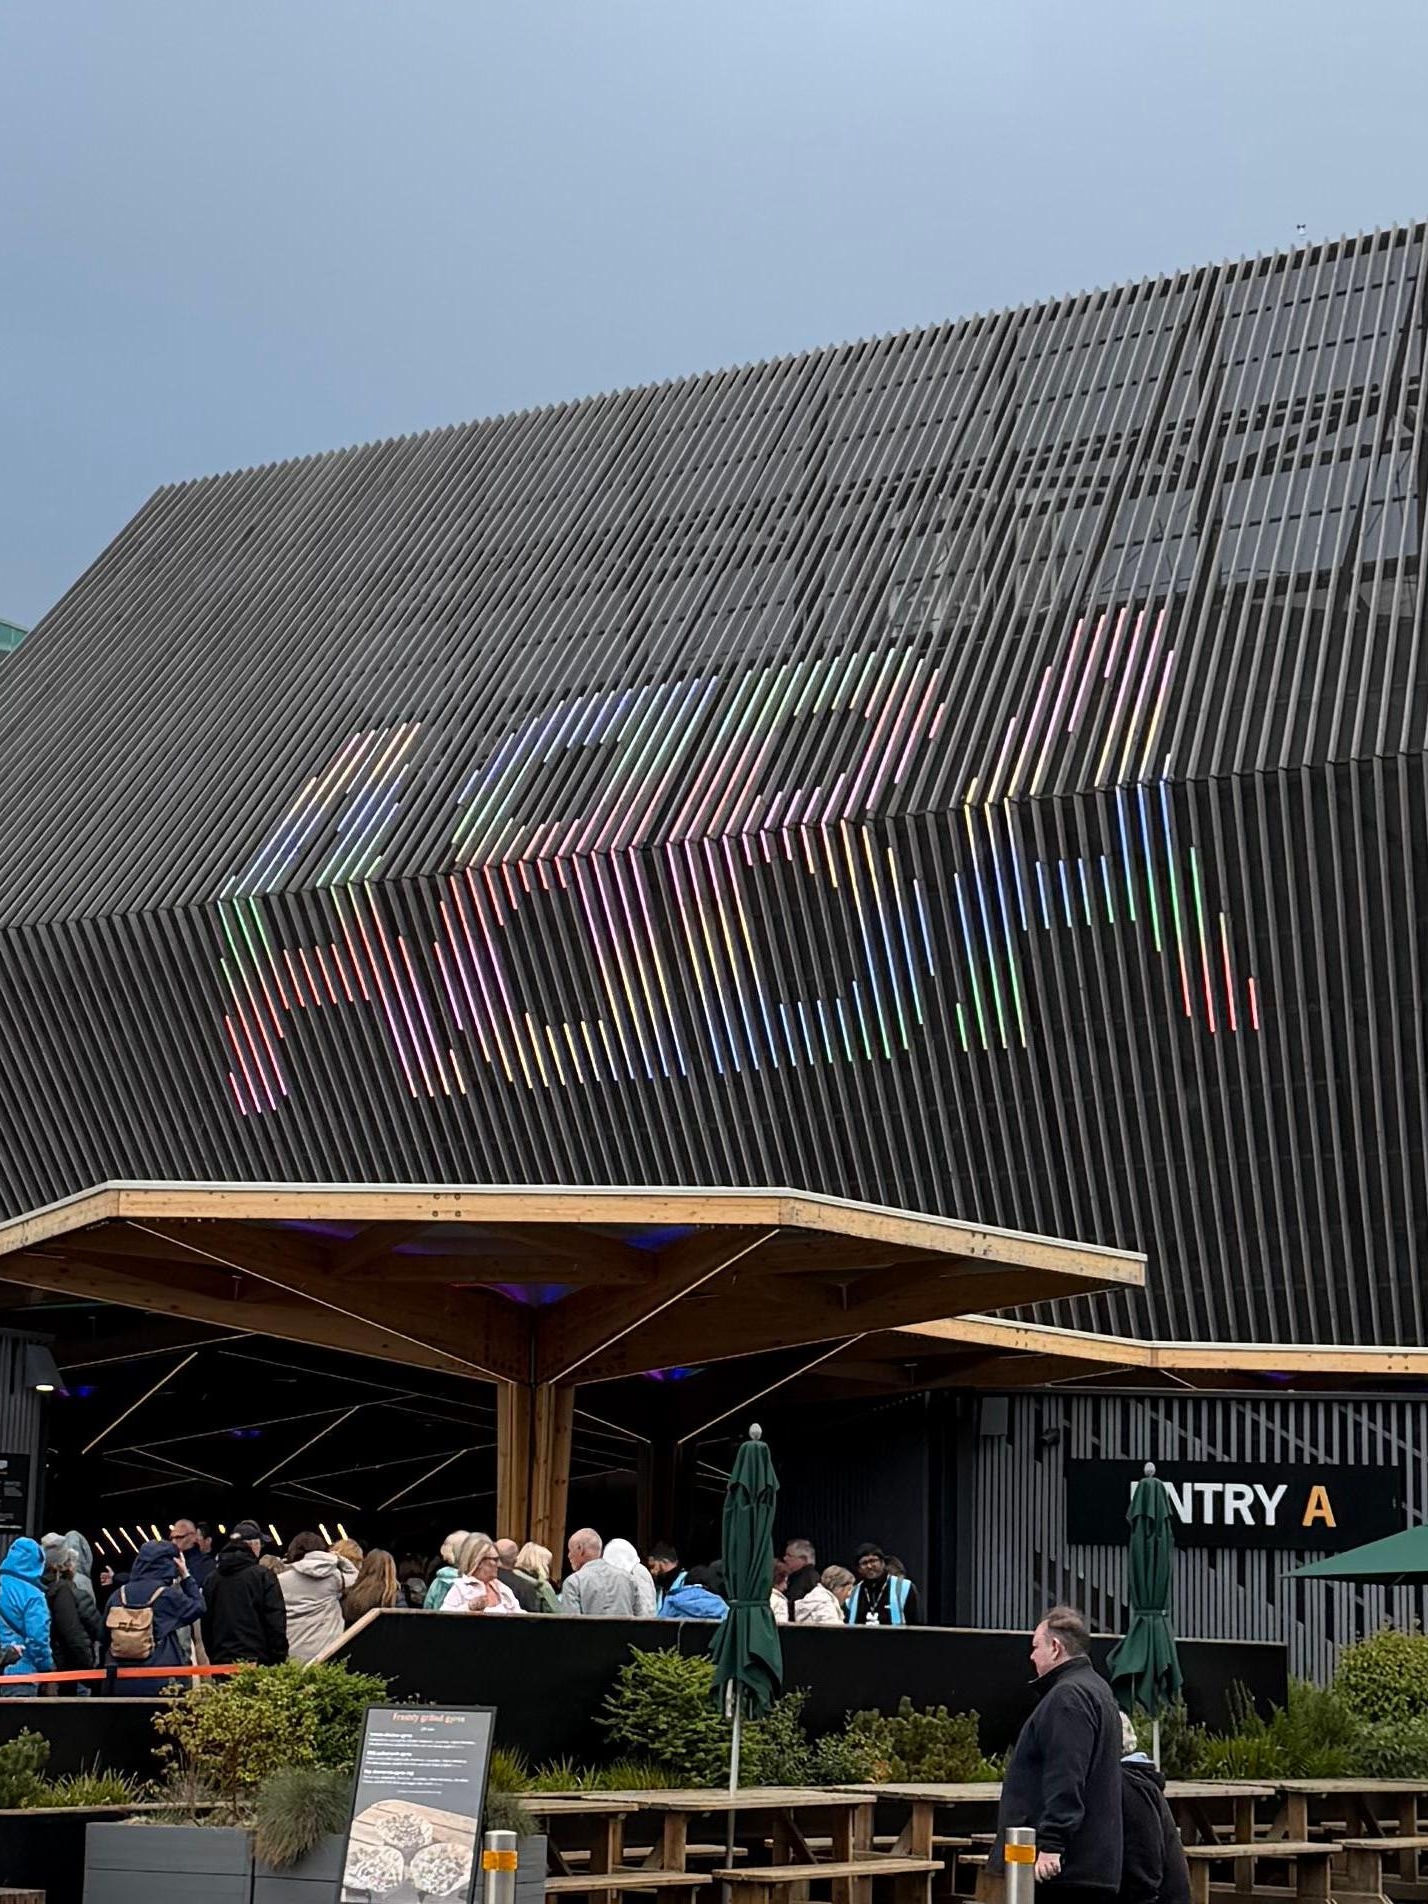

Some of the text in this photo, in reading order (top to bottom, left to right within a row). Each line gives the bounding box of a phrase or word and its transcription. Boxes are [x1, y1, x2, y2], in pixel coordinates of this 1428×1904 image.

[220, 607, 1260, 1115] ABBA
[1131, 1481, 1336, 1528] NTRY A
